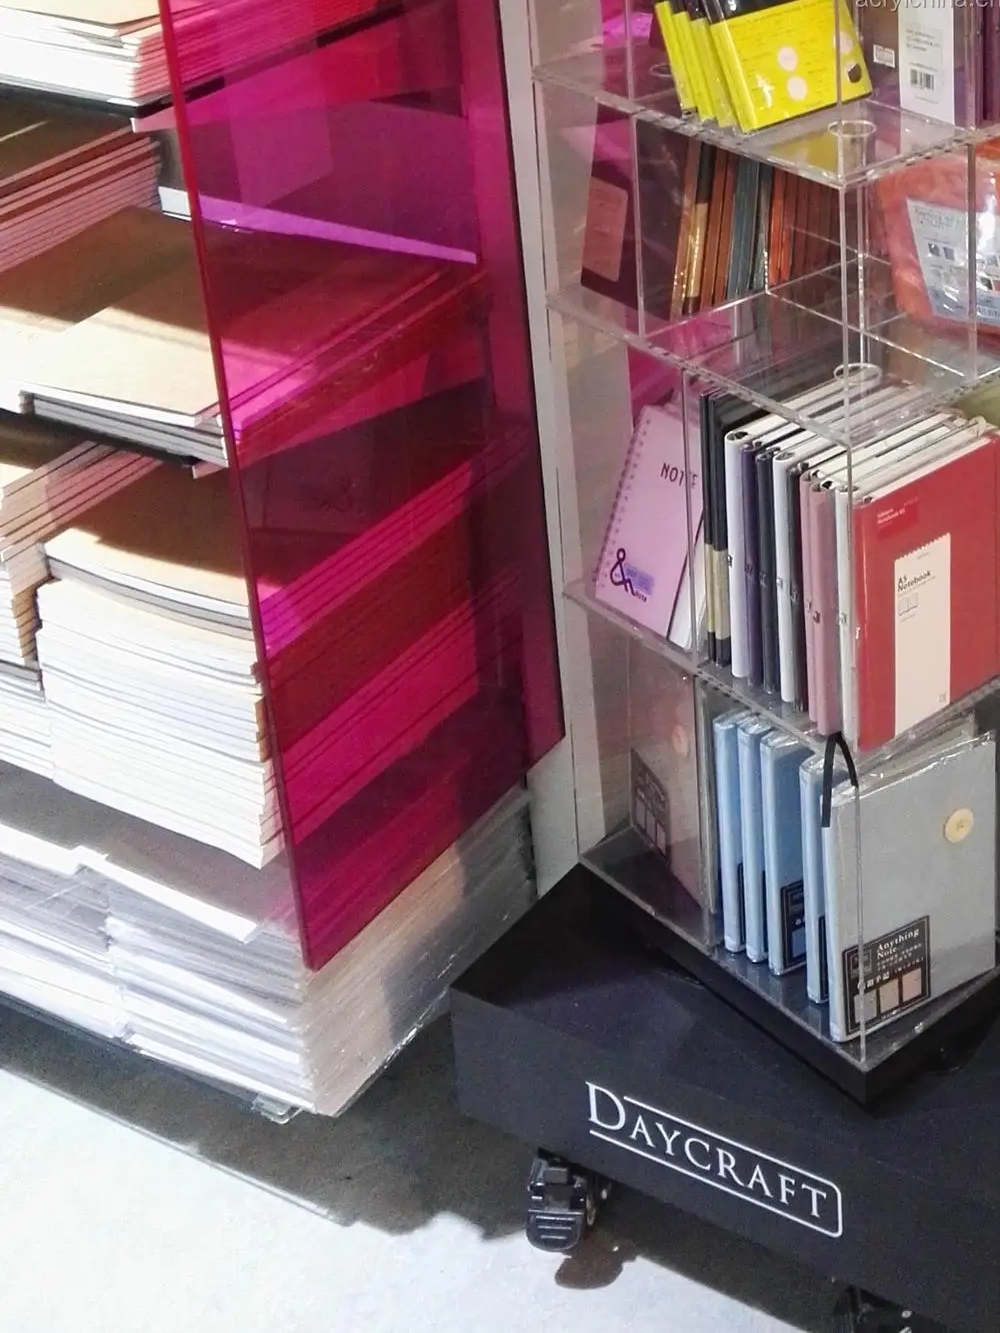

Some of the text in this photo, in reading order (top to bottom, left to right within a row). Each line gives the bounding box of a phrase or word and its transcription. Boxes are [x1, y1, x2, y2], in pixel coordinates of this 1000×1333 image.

[897, 570, 931, 592] Notebook
[877, 929, 920, 951] Anything
[877, 947, 897, 959] Note
[585, 1081, 827, 1218] DAYCRAFT
